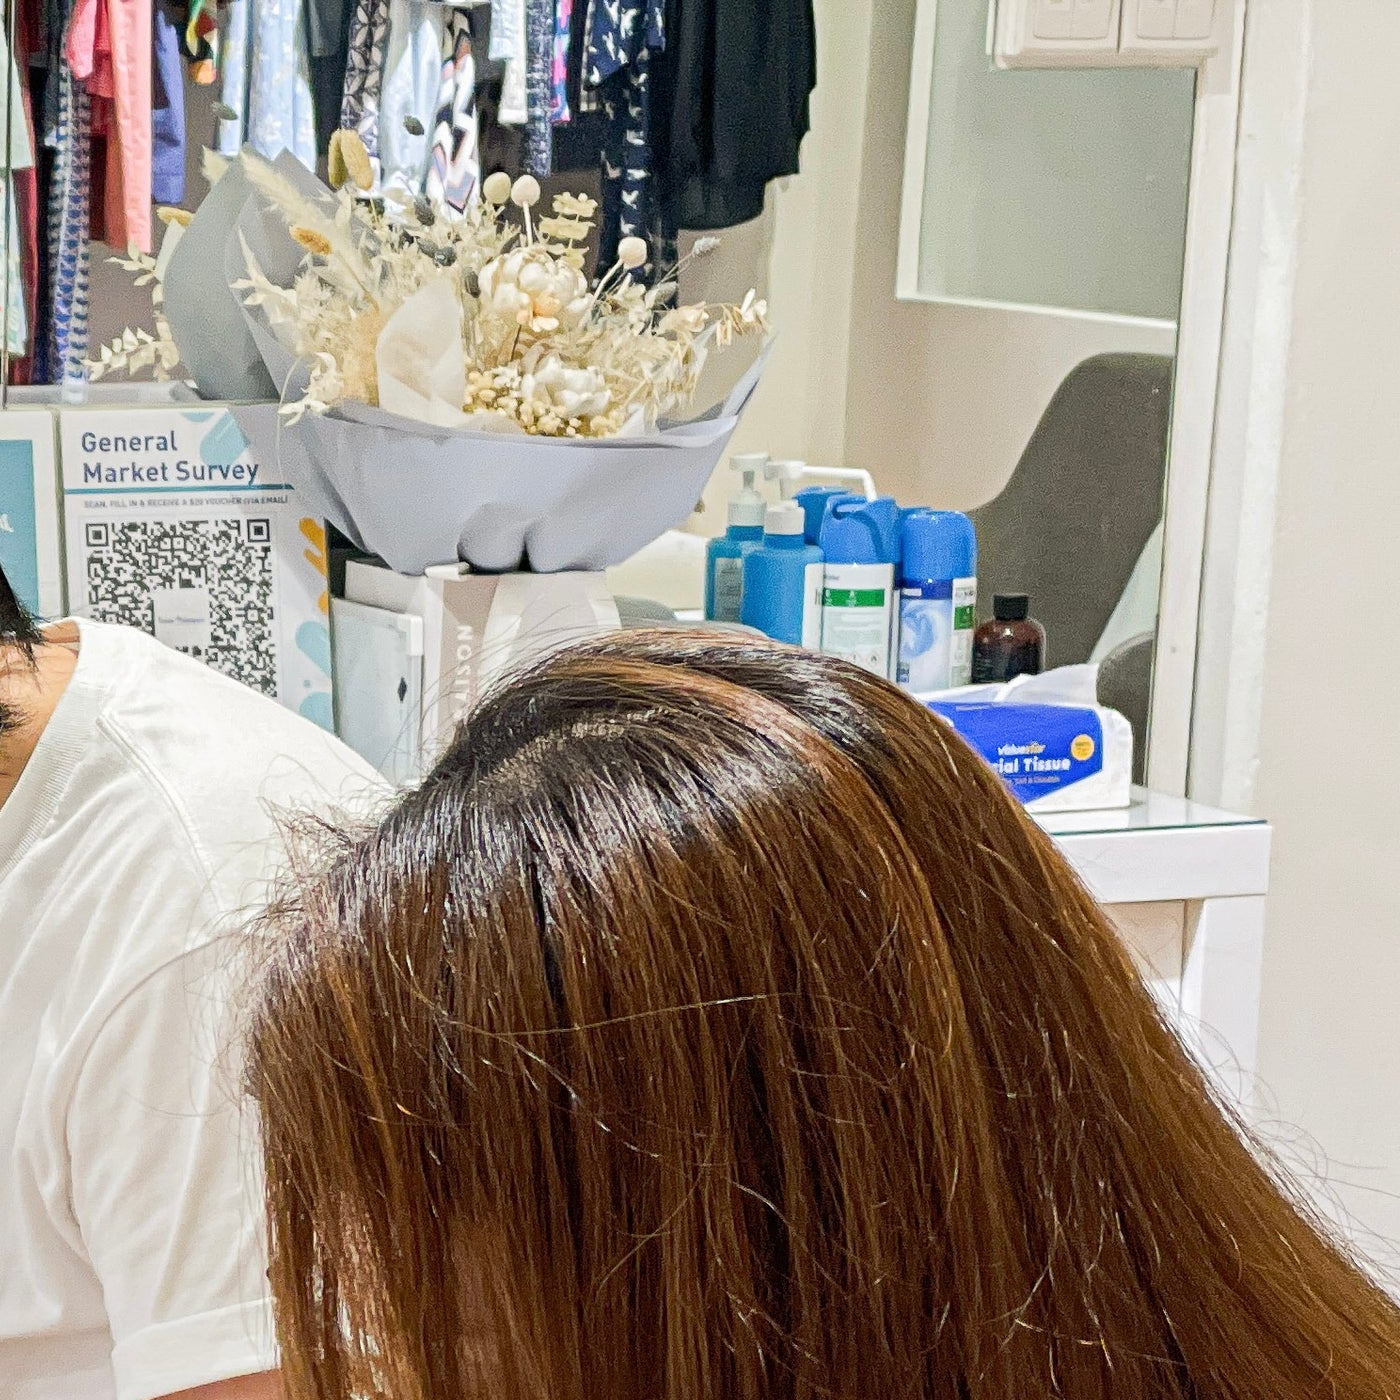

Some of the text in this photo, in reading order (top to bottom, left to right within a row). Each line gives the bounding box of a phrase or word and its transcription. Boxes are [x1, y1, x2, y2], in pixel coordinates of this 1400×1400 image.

[81, 430, 178, 453] General
[83, 460, 259, 486] Market Survey
[1024, 755, 1071, 772] Tissue
